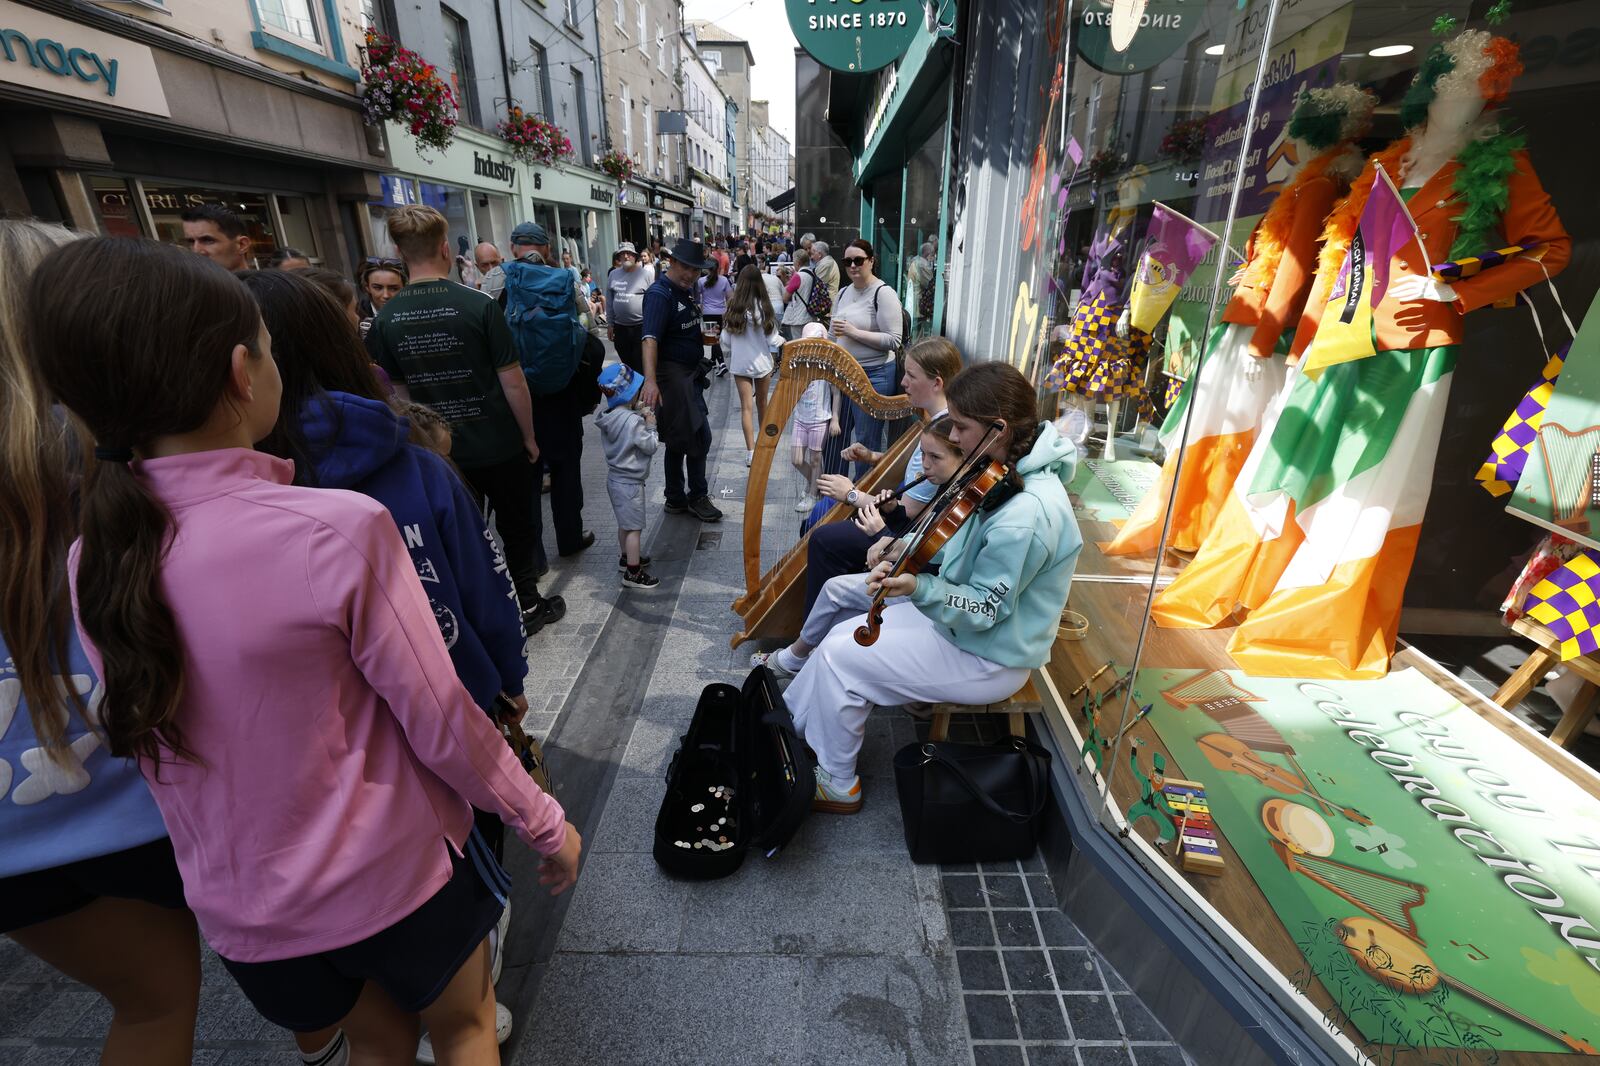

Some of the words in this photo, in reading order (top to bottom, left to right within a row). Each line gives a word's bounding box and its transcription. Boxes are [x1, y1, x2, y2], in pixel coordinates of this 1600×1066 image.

[809, 13, 862, 29] SINCE
[869, 12, 907, 26] 1870
[1353, 236, 1363, 262] LOCH
[414, 287, 426, 296] BIG
[427, 286, 449, 295] FELLA
[1349, 263, 1363, 307] GARMAN
